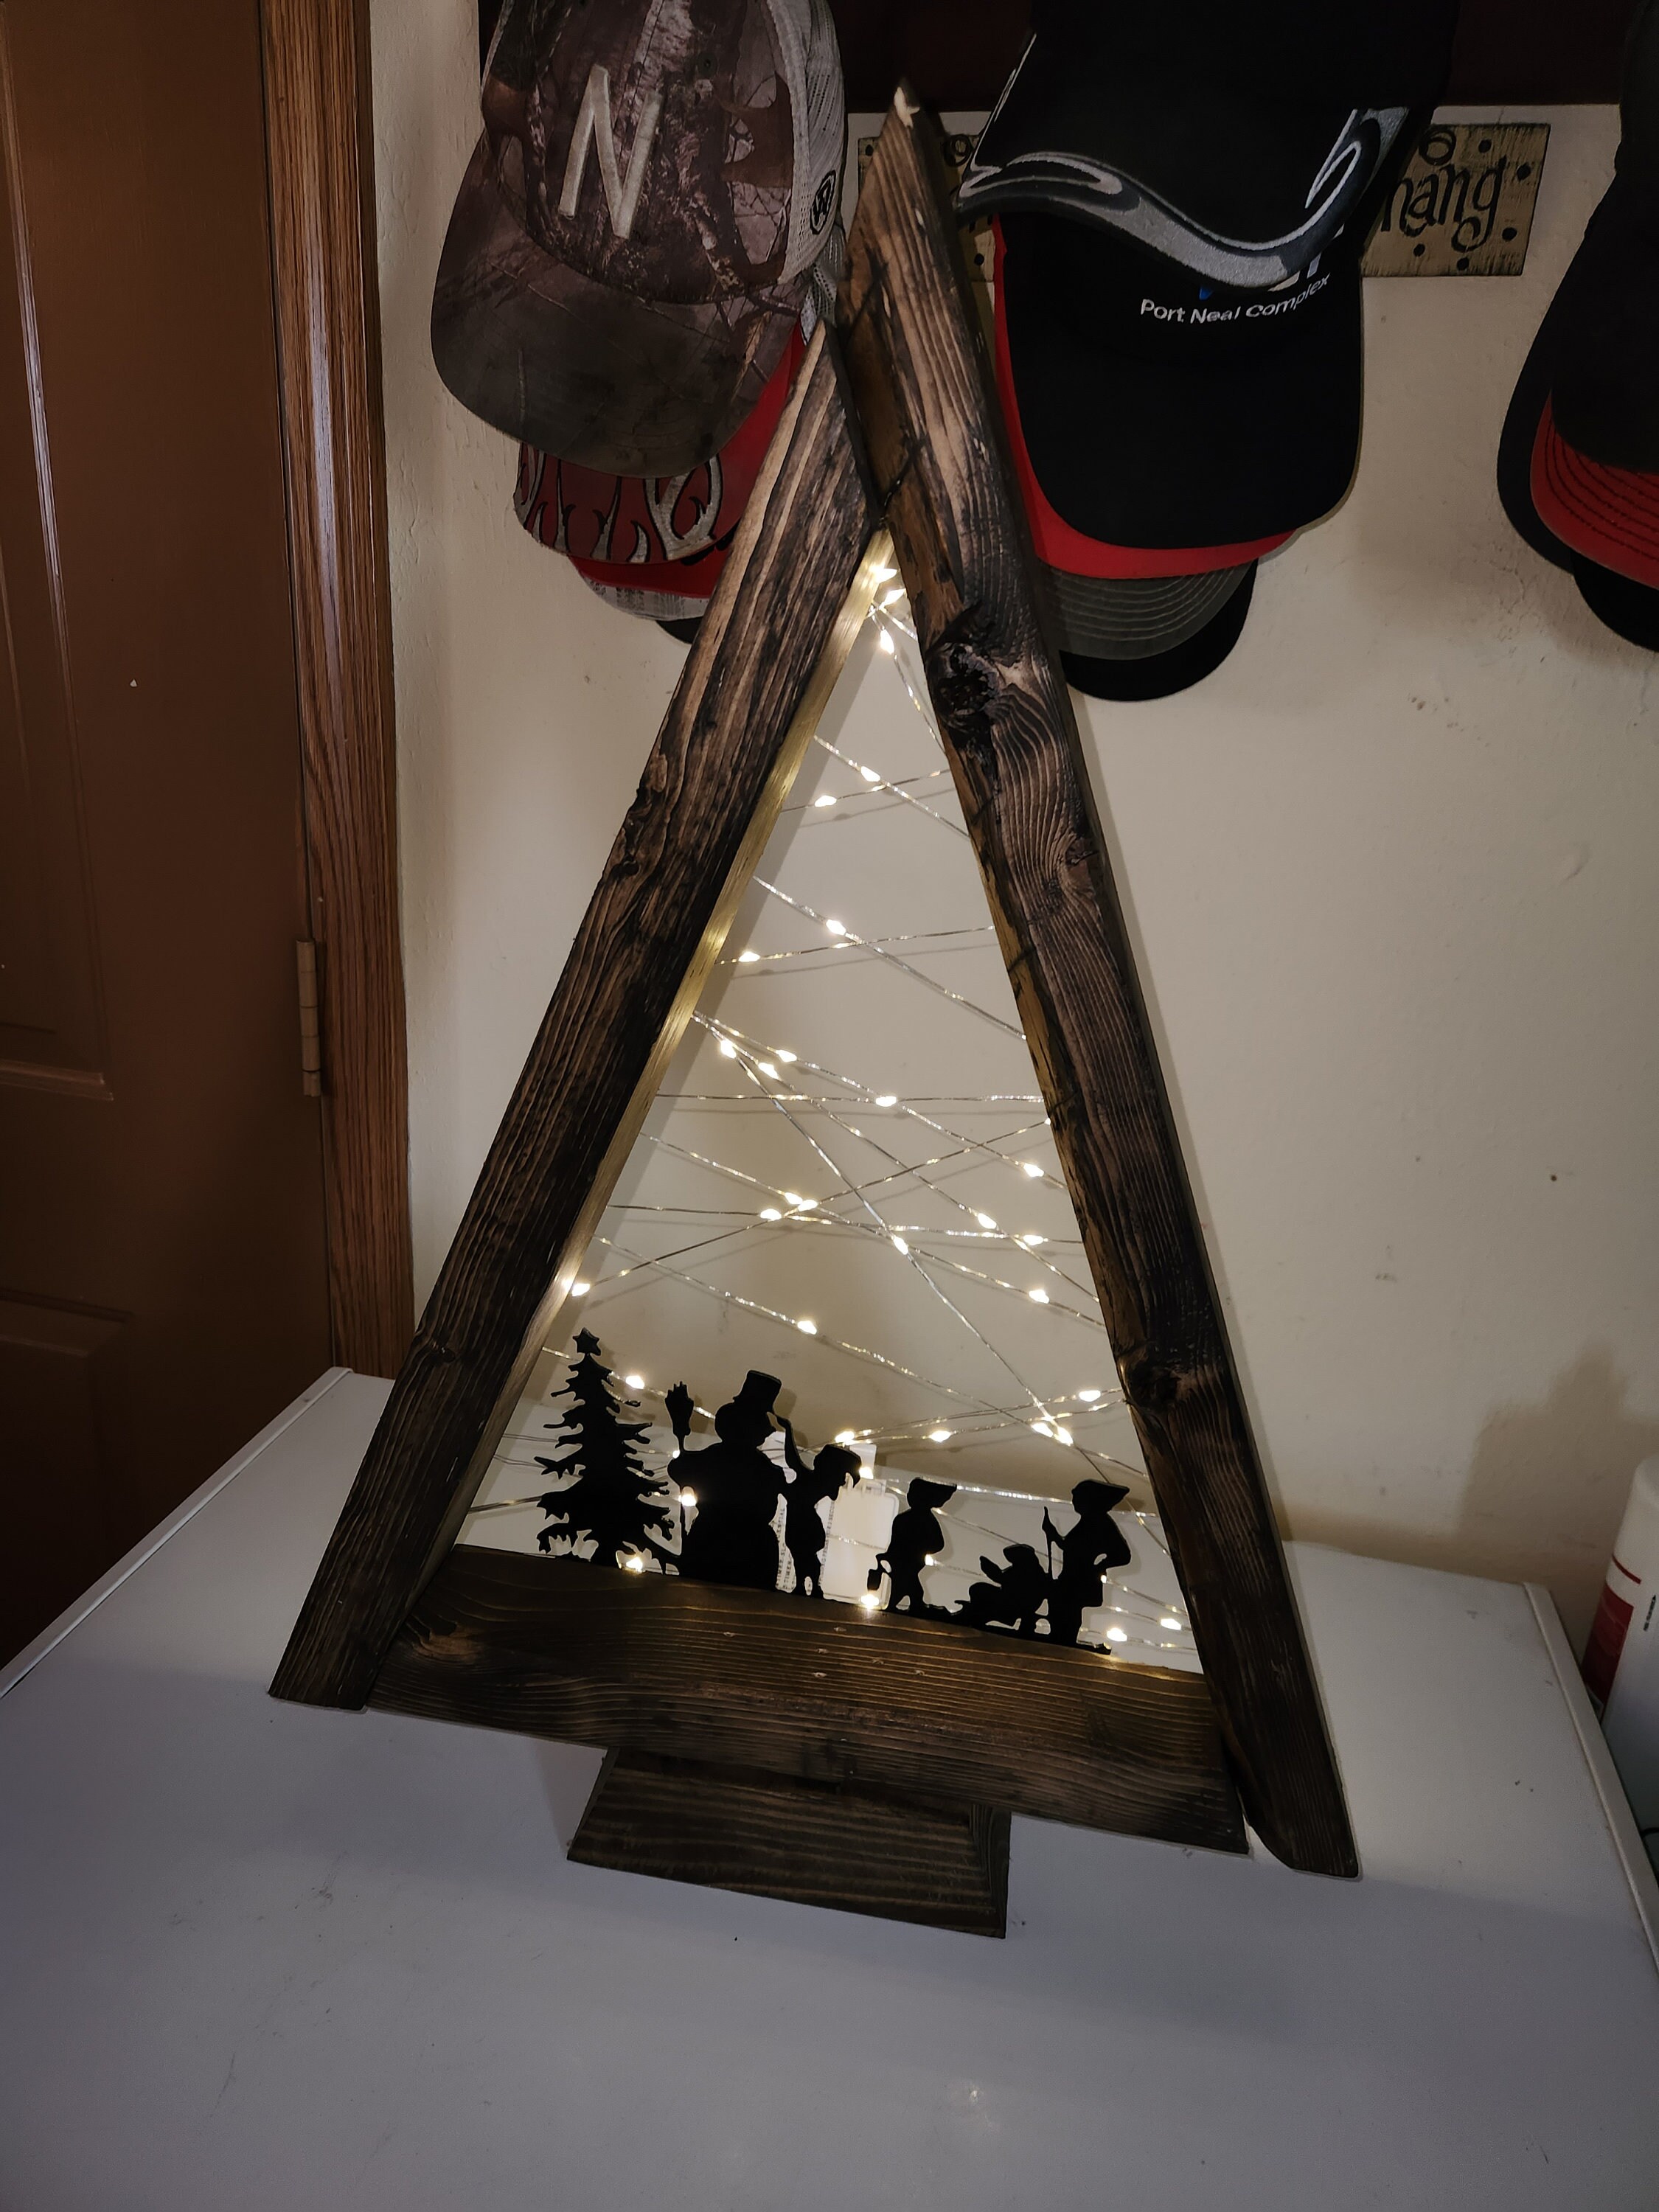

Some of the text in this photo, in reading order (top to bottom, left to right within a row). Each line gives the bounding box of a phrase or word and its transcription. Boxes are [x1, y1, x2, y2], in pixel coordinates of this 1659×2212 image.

[558, 63, 663, 240] N
[1141, 271, 1331, 324] Port Neal Complex
